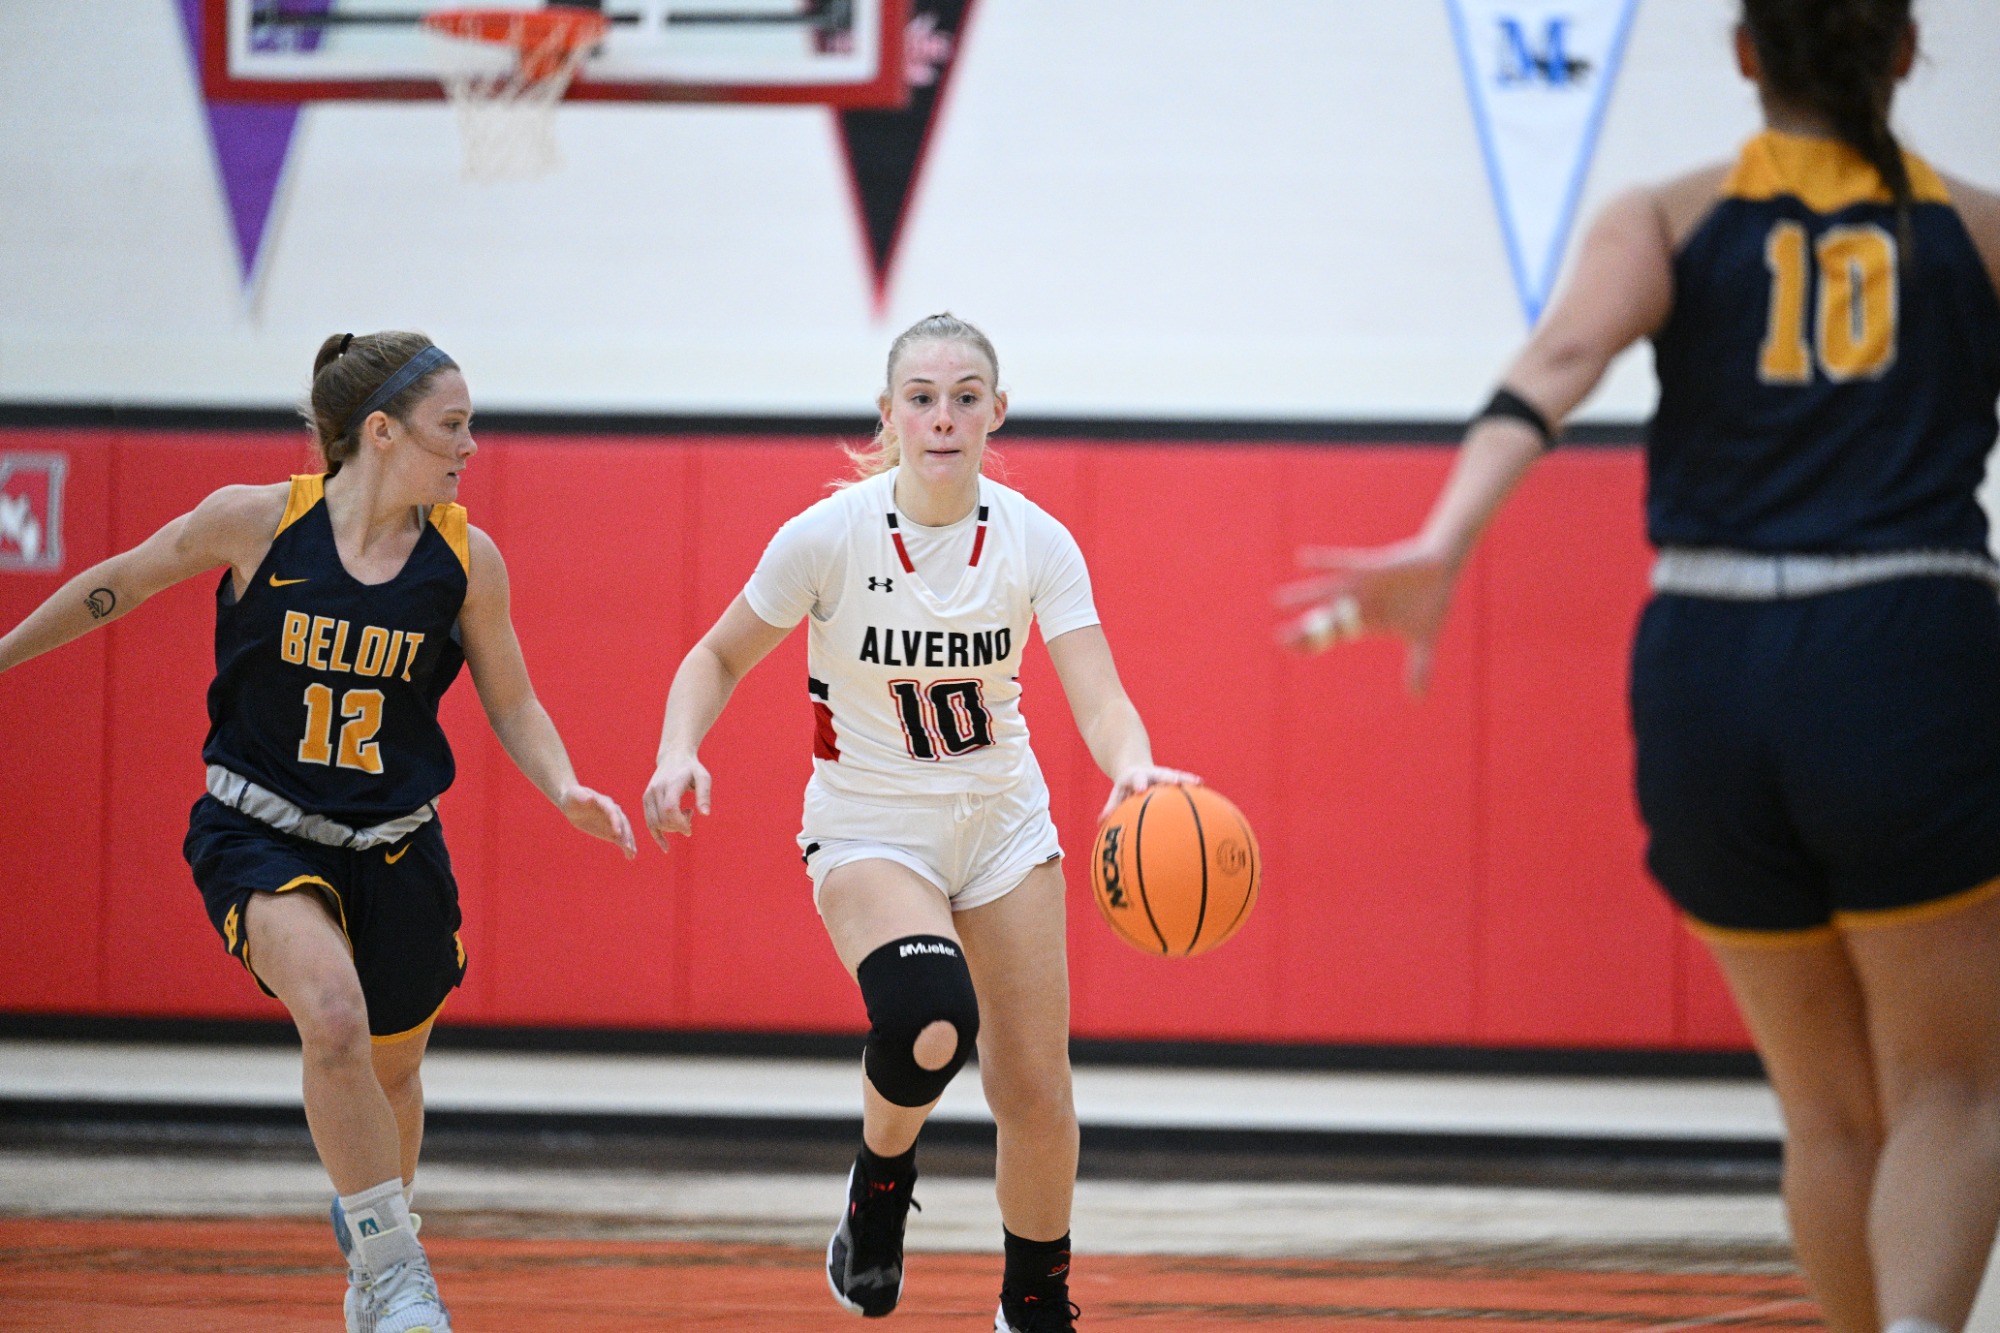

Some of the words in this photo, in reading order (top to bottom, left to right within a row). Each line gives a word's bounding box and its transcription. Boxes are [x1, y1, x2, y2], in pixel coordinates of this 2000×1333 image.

[1757, 217, 1898, 384] 10
[281, 609, 425, 682] BELOIT
[859, 626, 1012, 668] ALVERNO
[297, 682, 386, 774] 12
[887, 678, 996, 762] 10
